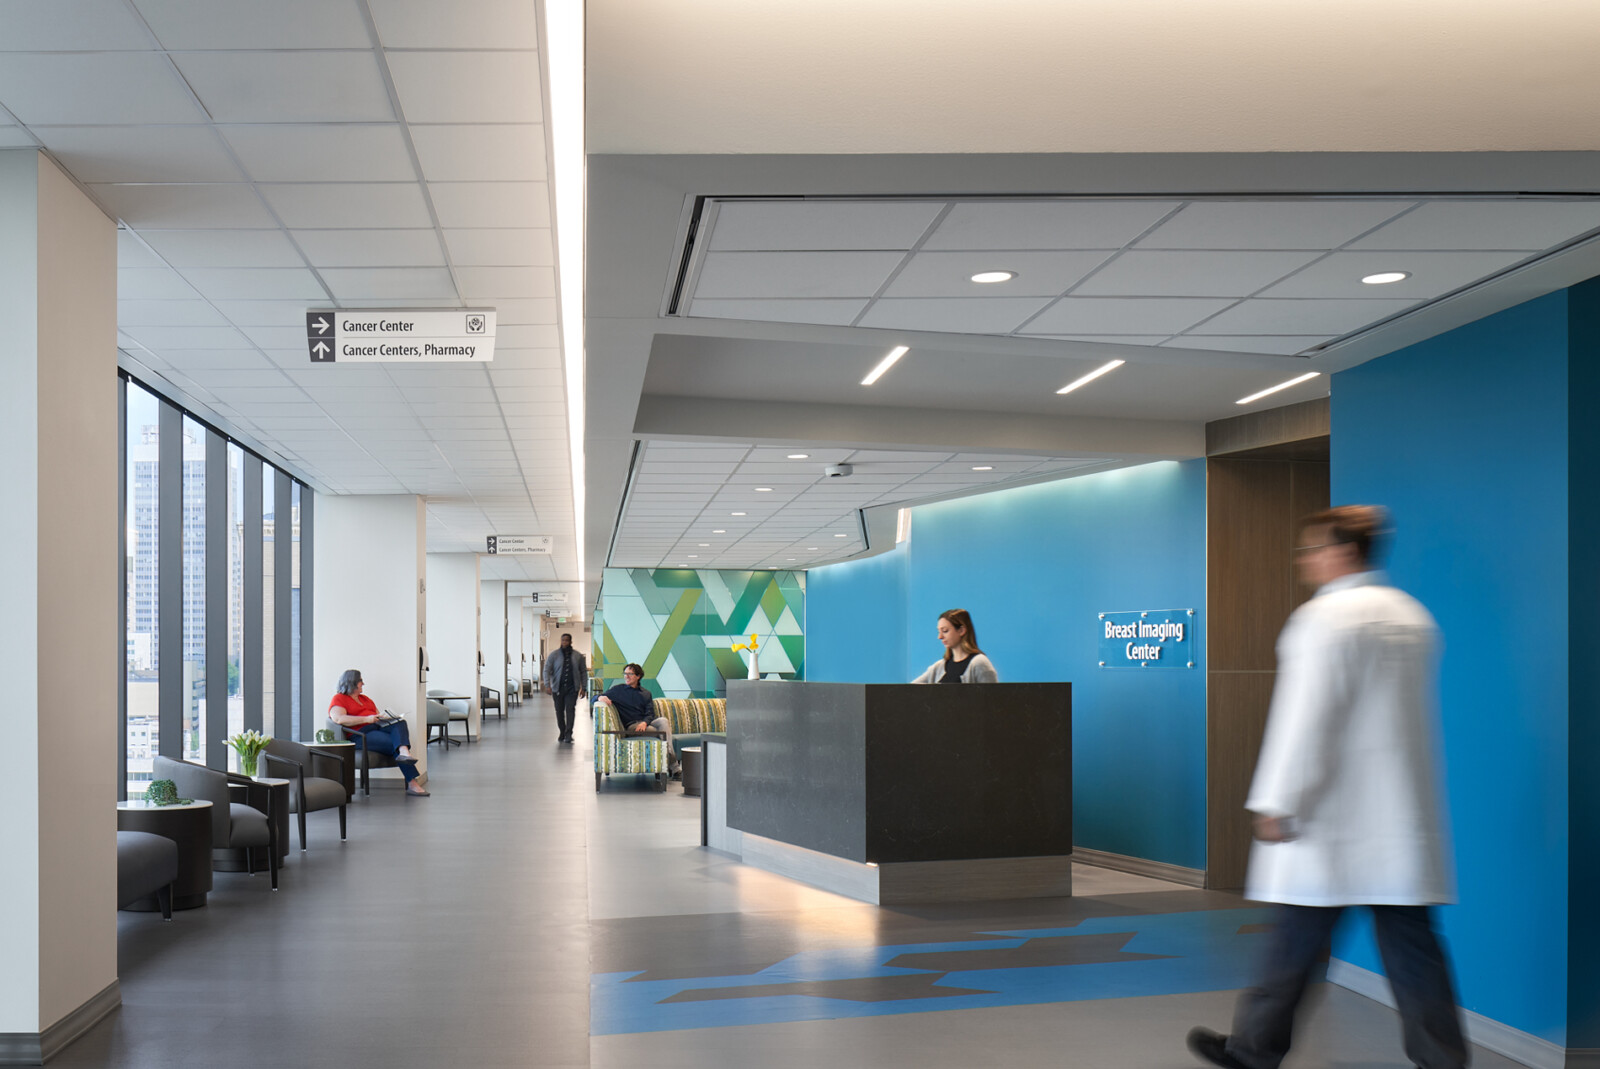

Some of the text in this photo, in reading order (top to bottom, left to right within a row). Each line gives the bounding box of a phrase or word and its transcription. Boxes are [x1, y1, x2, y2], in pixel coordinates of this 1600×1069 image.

[342, 320, 414, 332] Cancer Center
[342, 343, 476, 358] Cancer Centers, Pharmacy
[1105, 619, 1184, 642] Breast Imaging
[1126, 642, 1161, 660] Center
